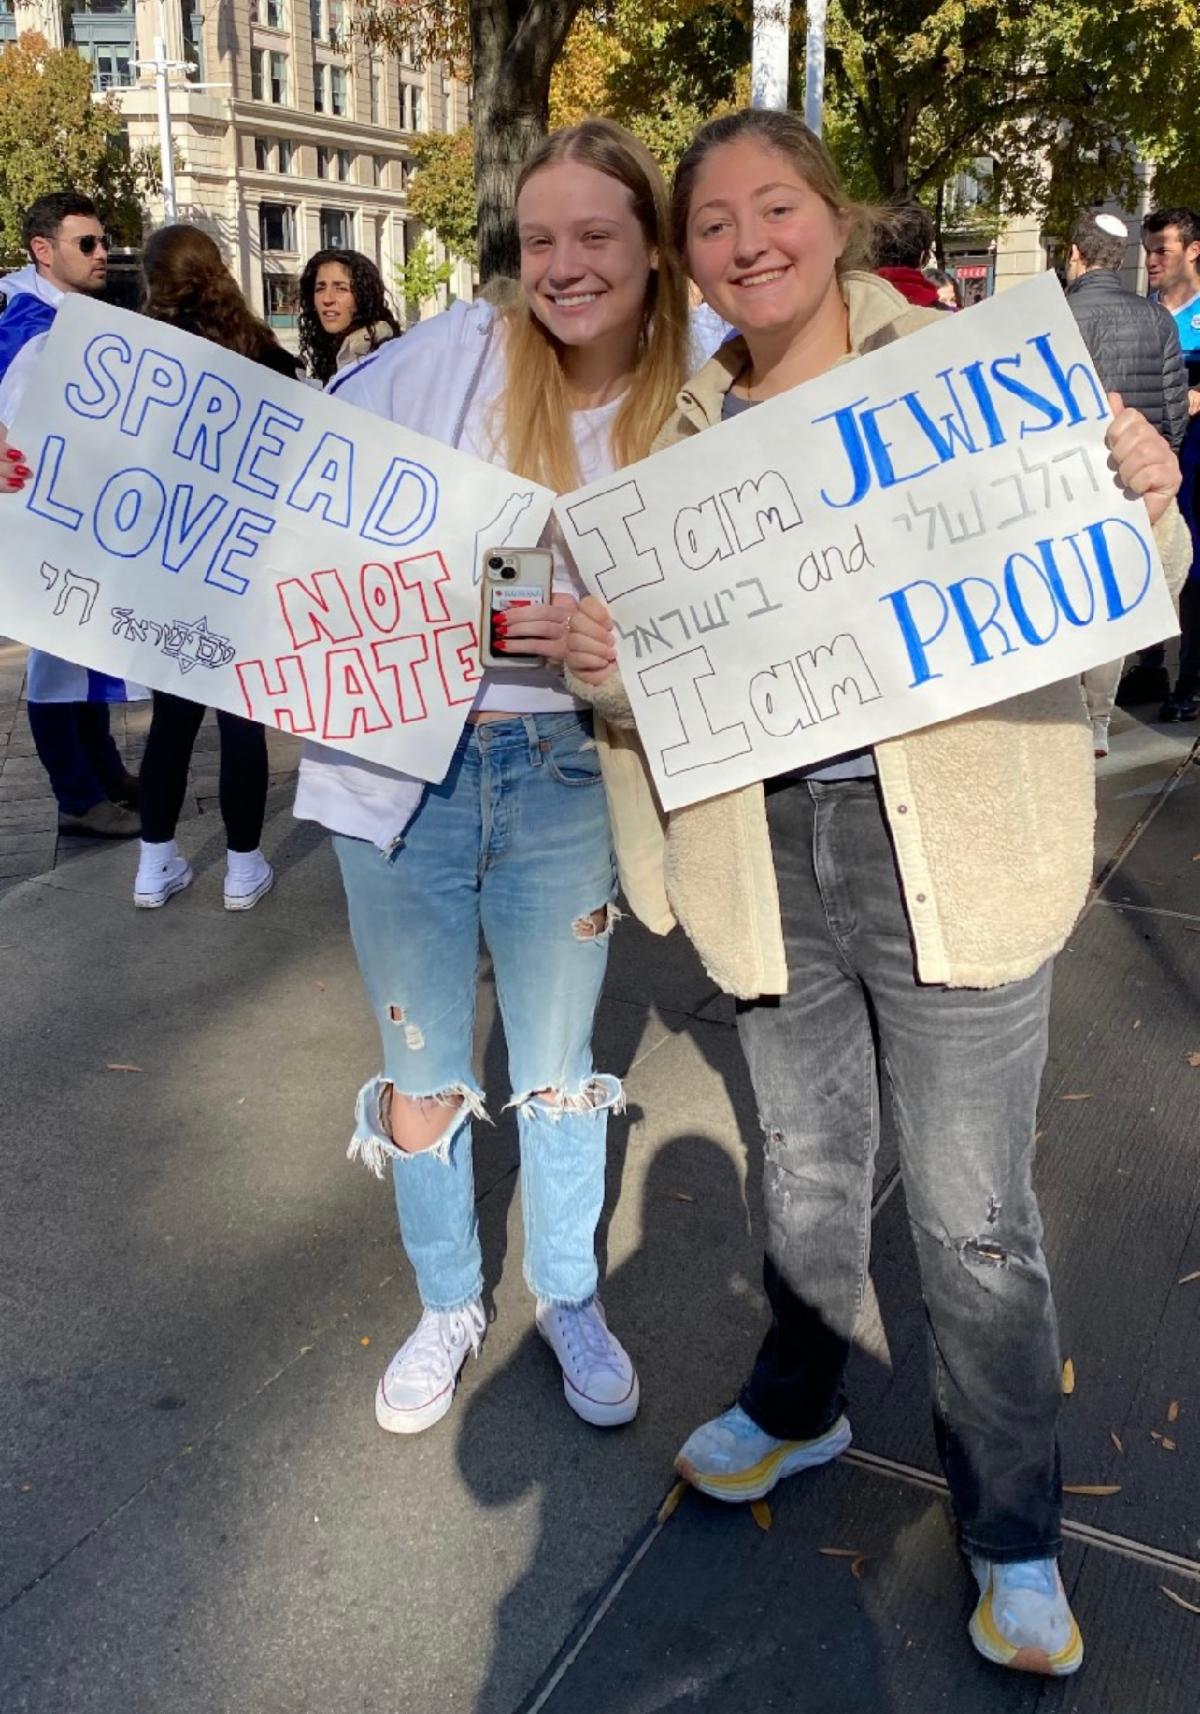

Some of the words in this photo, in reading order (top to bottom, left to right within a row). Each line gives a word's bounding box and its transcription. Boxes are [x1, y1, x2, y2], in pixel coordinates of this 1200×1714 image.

[65, 333, 440, 547] SPREAD
[990, 446, 1100, 530] הלב
[27, 435, 276, 595] LOVE
[565, 479, 665, 604] I
[673, 469, 803, 571] am
[796, 525, 875, 592] and
[893, 487, 987, 551] שלי
[40, 560, 100, 626] חי
[277, 550, 452, 650] NOT
[613, 577, 783, 658] בישראל
[235, 621, 482, 740] HATE
[638, 645, 753, 777] I
[749, 634, 883, 737] am
[878, 518, 1152, 690] PROUD
